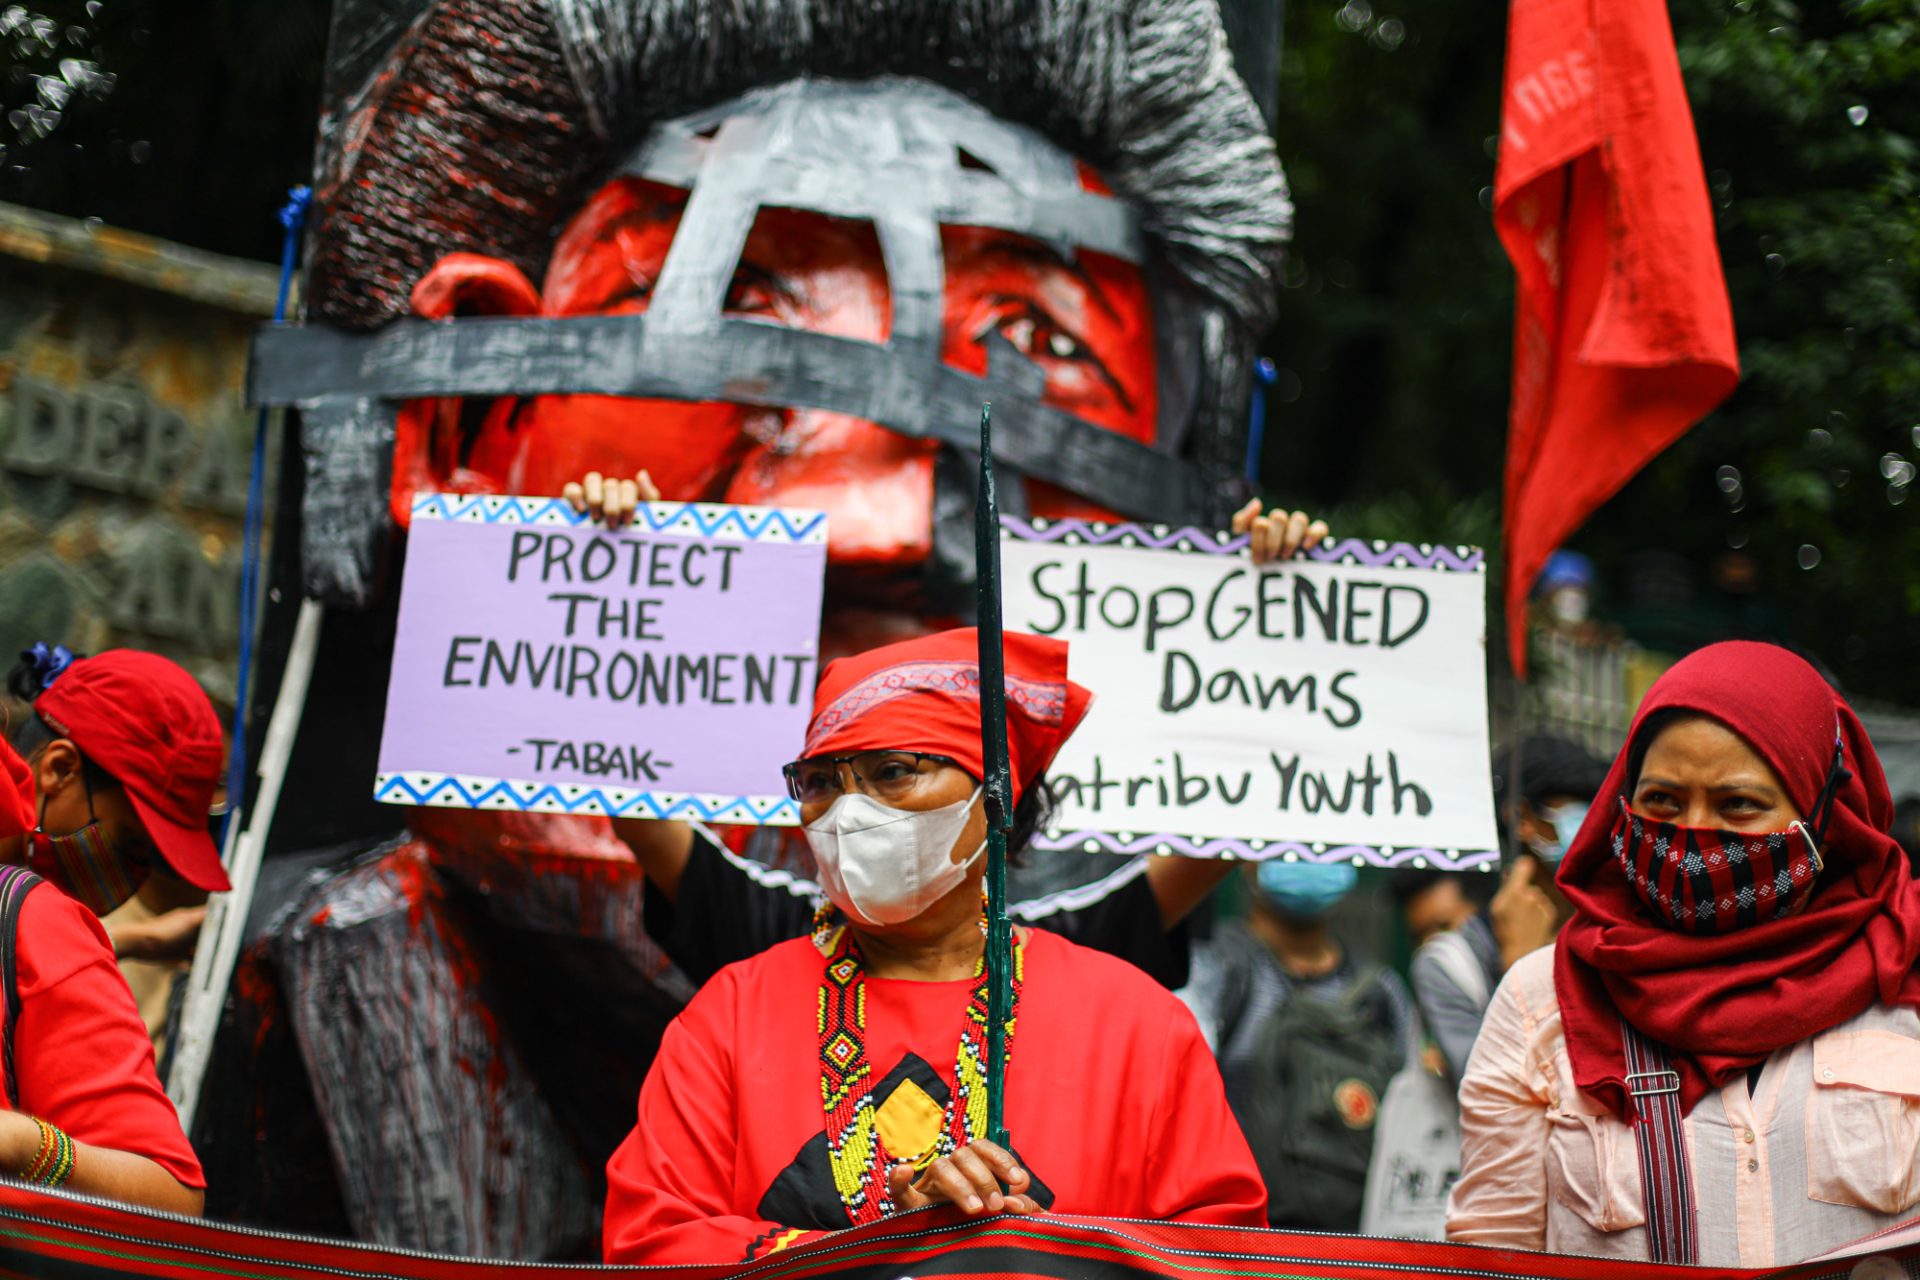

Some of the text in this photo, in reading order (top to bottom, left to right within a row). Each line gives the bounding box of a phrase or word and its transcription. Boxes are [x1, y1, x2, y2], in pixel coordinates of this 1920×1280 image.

[506, 529, 742, 593] PROTECT
[546, 592, 665, 641] THE
[1028, 559, 1430, 652] Stop GENED
[443, 635, 814, 707] ENVIRONMENT
[1159, 649, 1363, 729] Dams
[1052, 749, 1434, 818] atribu Youth
